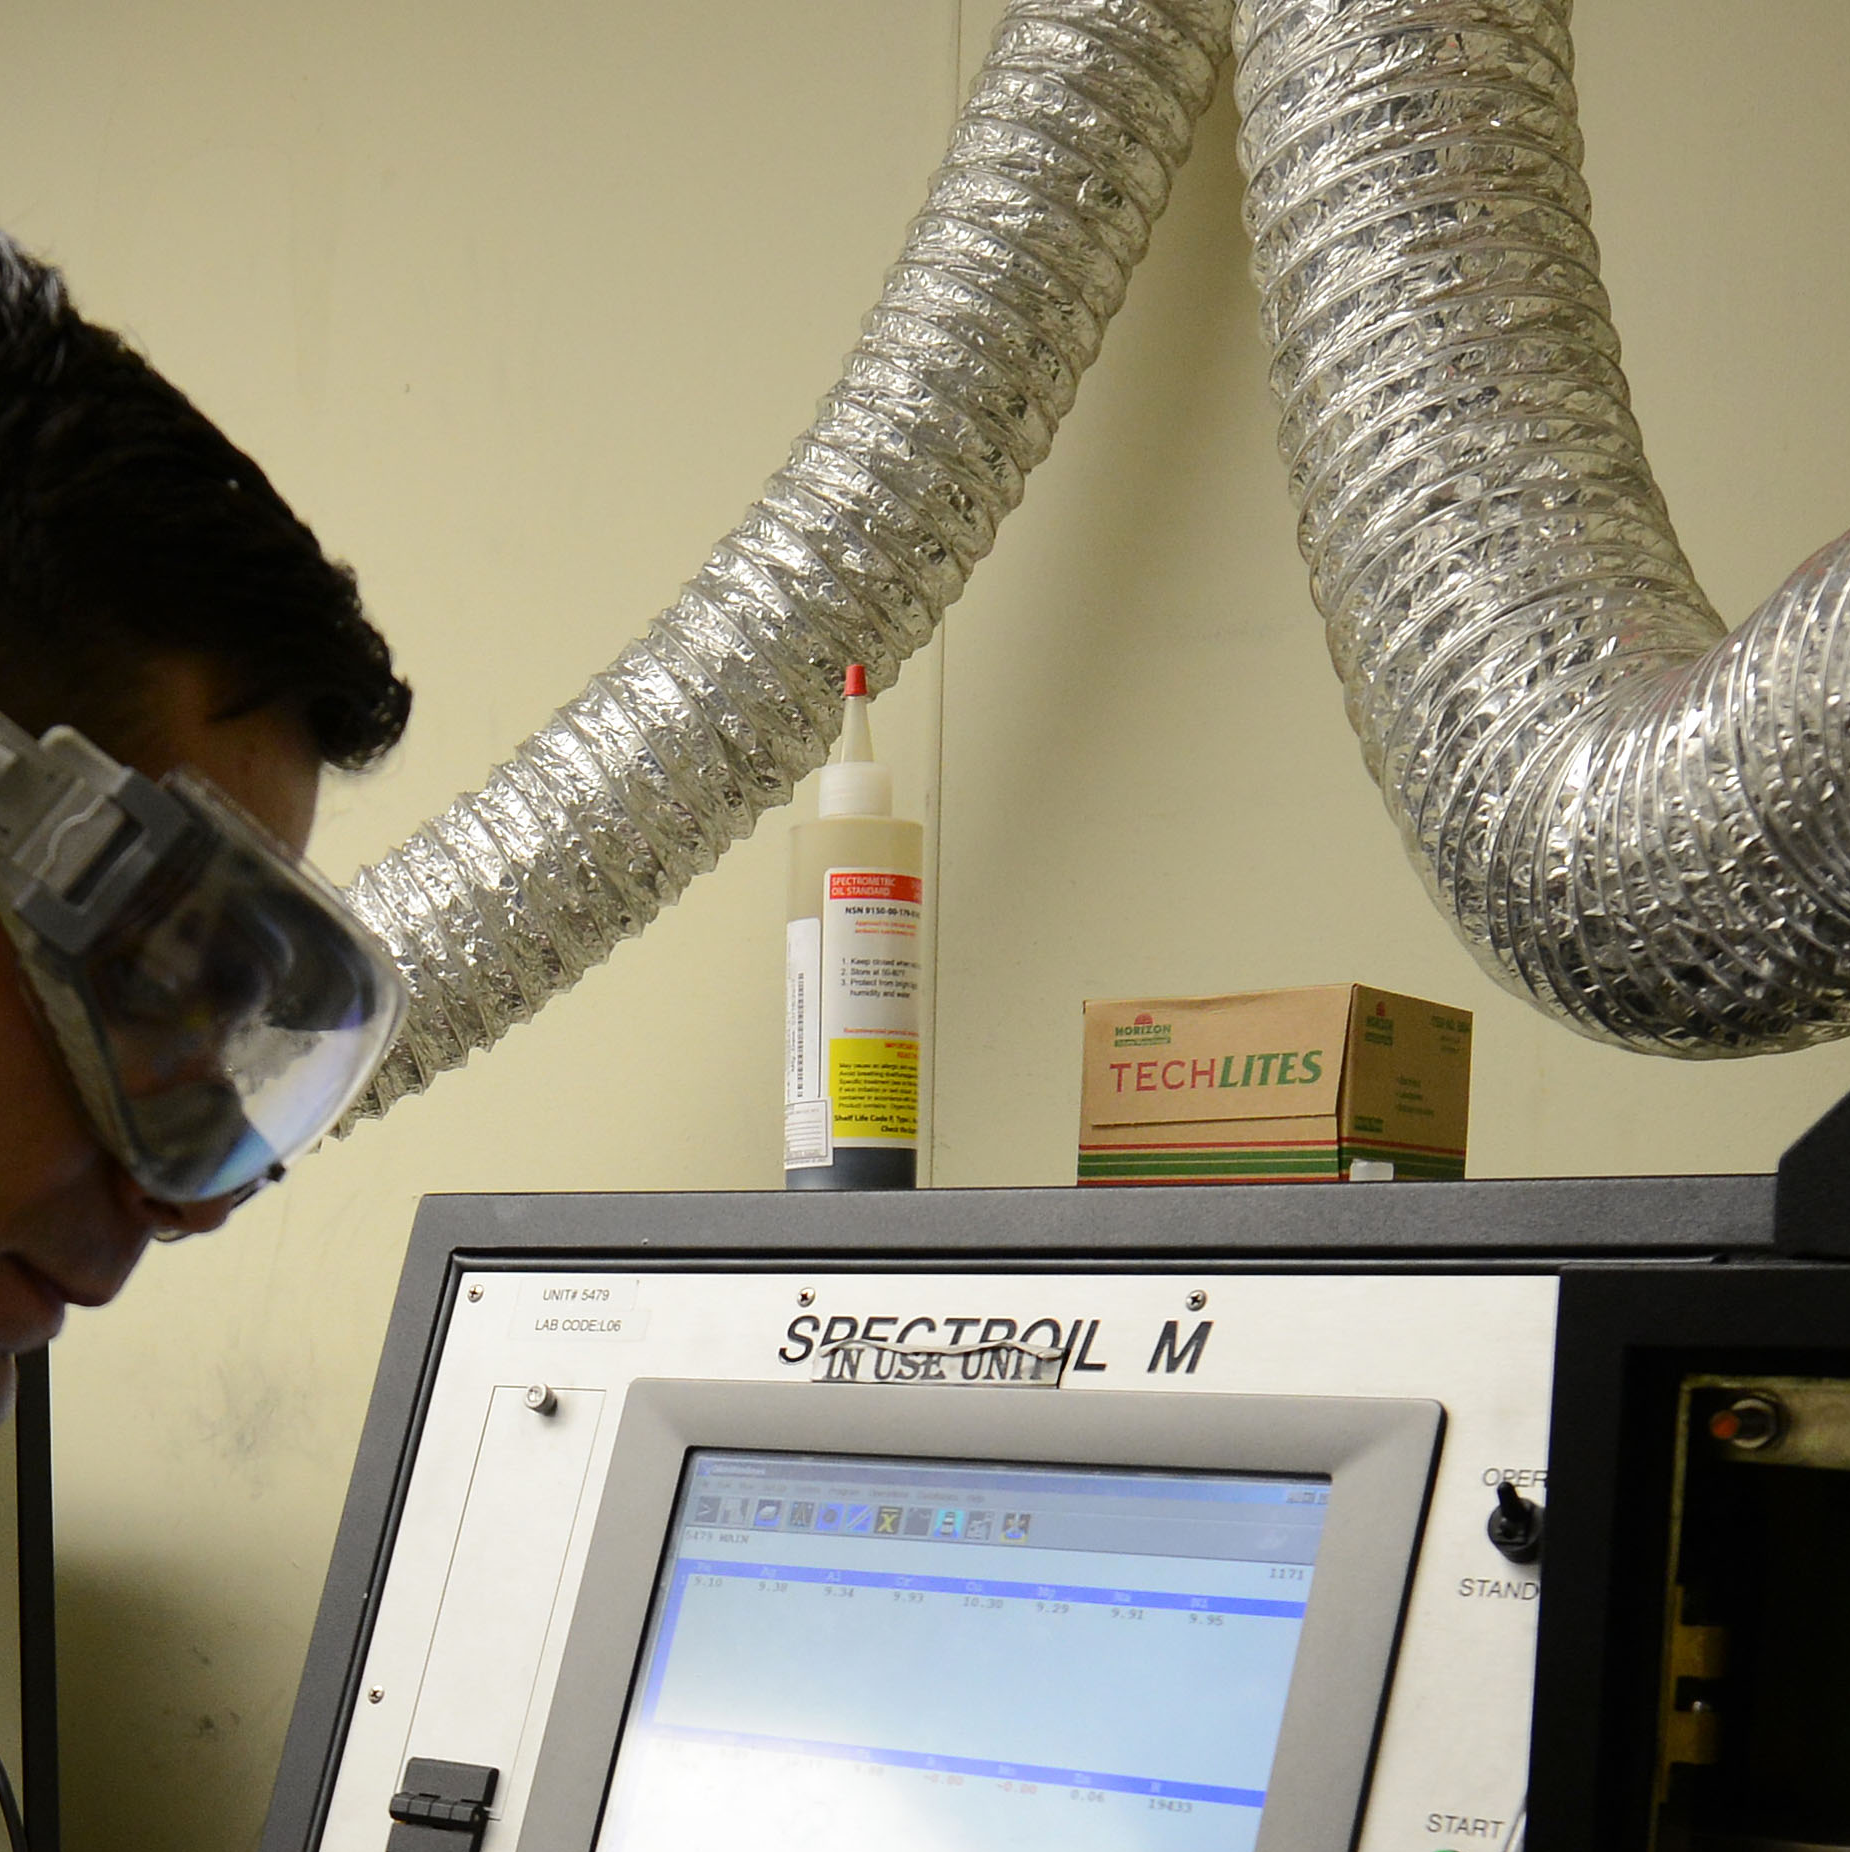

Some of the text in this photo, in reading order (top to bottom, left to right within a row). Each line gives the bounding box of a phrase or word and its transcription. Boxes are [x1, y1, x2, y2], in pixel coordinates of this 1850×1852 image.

[832, 877, 896, 887] SPECTROMETRIC
[832, 887, 891, 896] OIL STANDARD
[845, 906, 864, 915] NSN
[1114, 1024, 1172, 1037] HORIZON
[1109, 1050, 1324, 1093] TECHLITES
[543, 1288, 610, 1301] UNIT# 5479
[534, 1318, 559, 1331] LAB
[1146, 1320, 1214, 1374] M
[824, 1347, 866, 1380] IN
[872, 1347, 946, 1381] USE
[717, 1533, 750, 1545] MAIN
[1457, 1577, 1540, 1600] STAND
[1110, 1608, 1143, 1621] 9.91
[1187, 1613, 1224, 1627] 9.95
[1426, 1813, 1505, 1839] START
